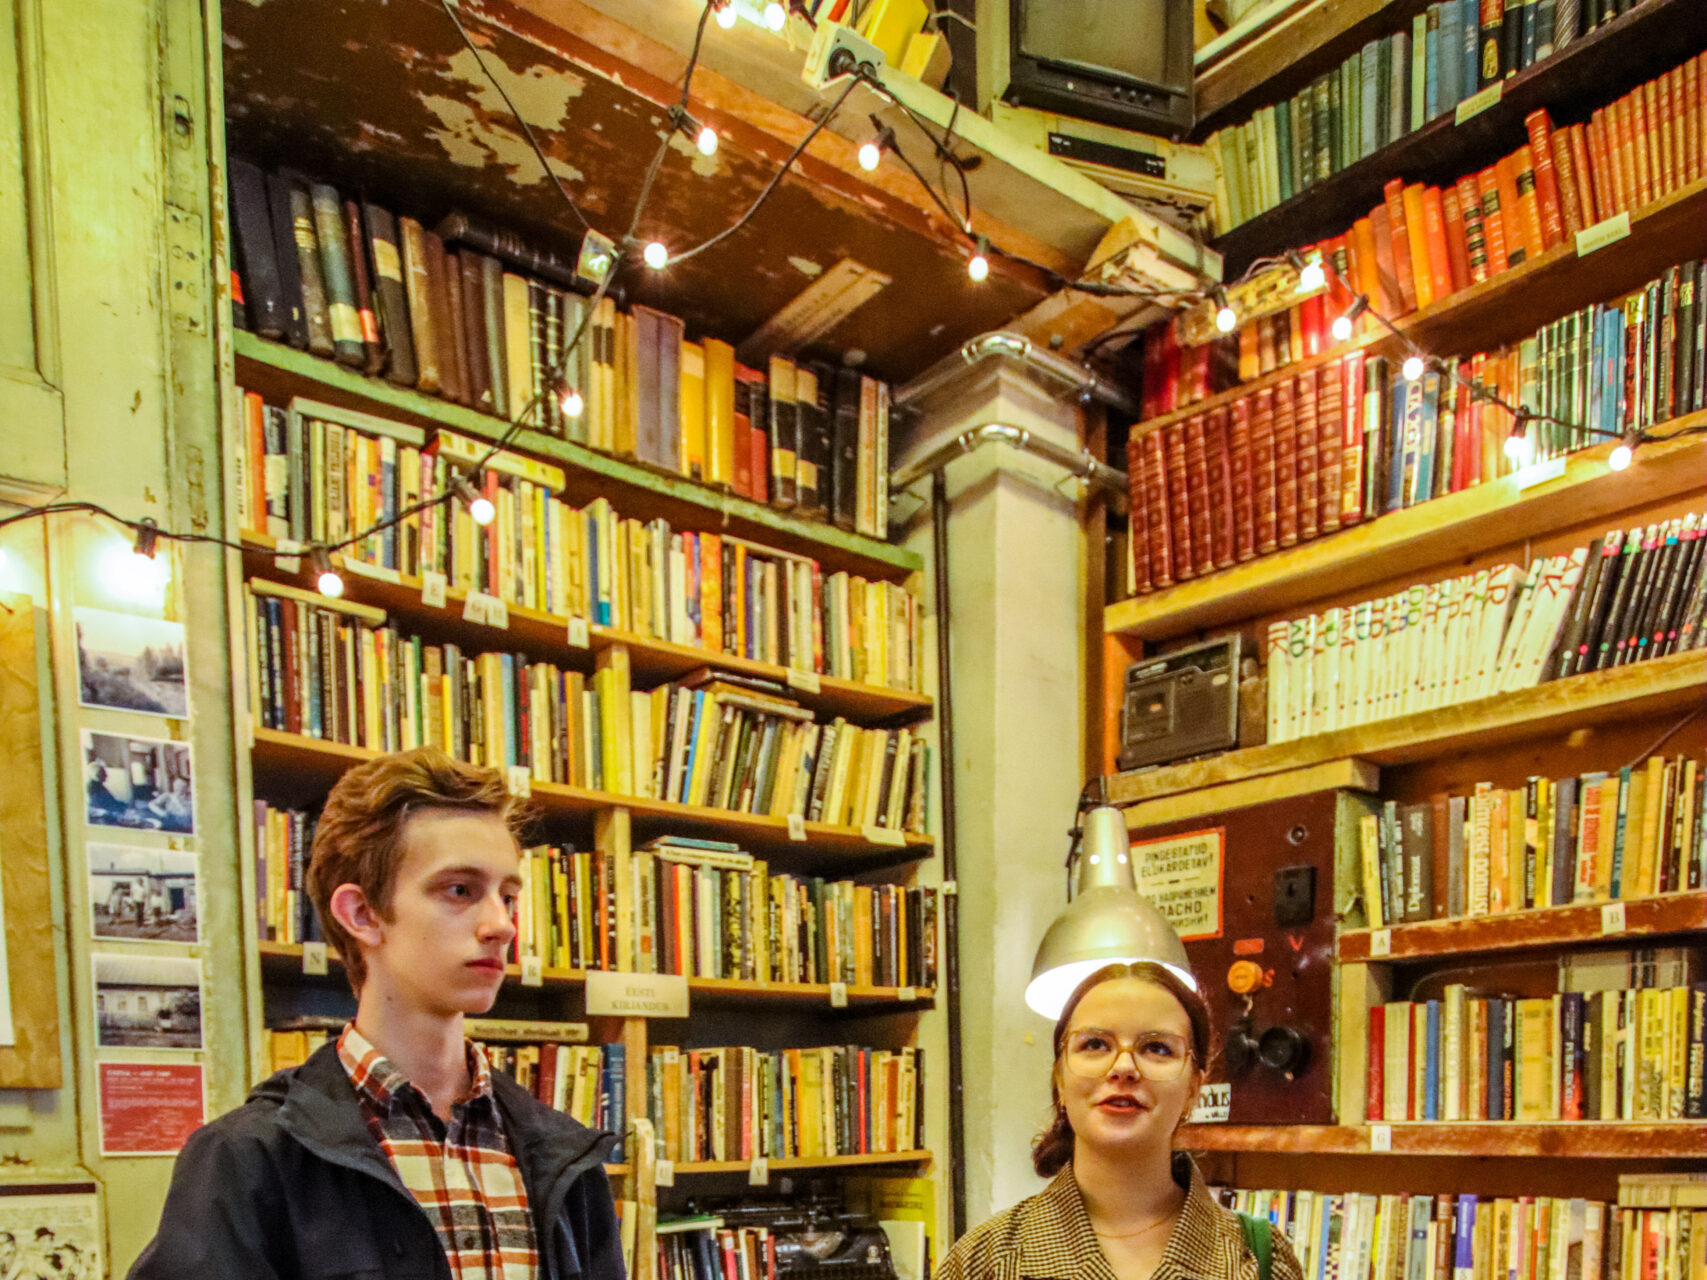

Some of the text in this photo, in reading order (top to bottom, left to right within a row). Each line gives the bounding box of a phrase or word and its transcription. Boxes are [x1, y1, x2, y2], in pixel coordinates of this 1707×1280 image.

[1609, 912, 1620, 924] B
[1379, 936, 1387, 948] A
[310, 953, 321, 966] N
[624, 986, 655, 998] EESTI
[1377, 1132, 1387, 1145] G
